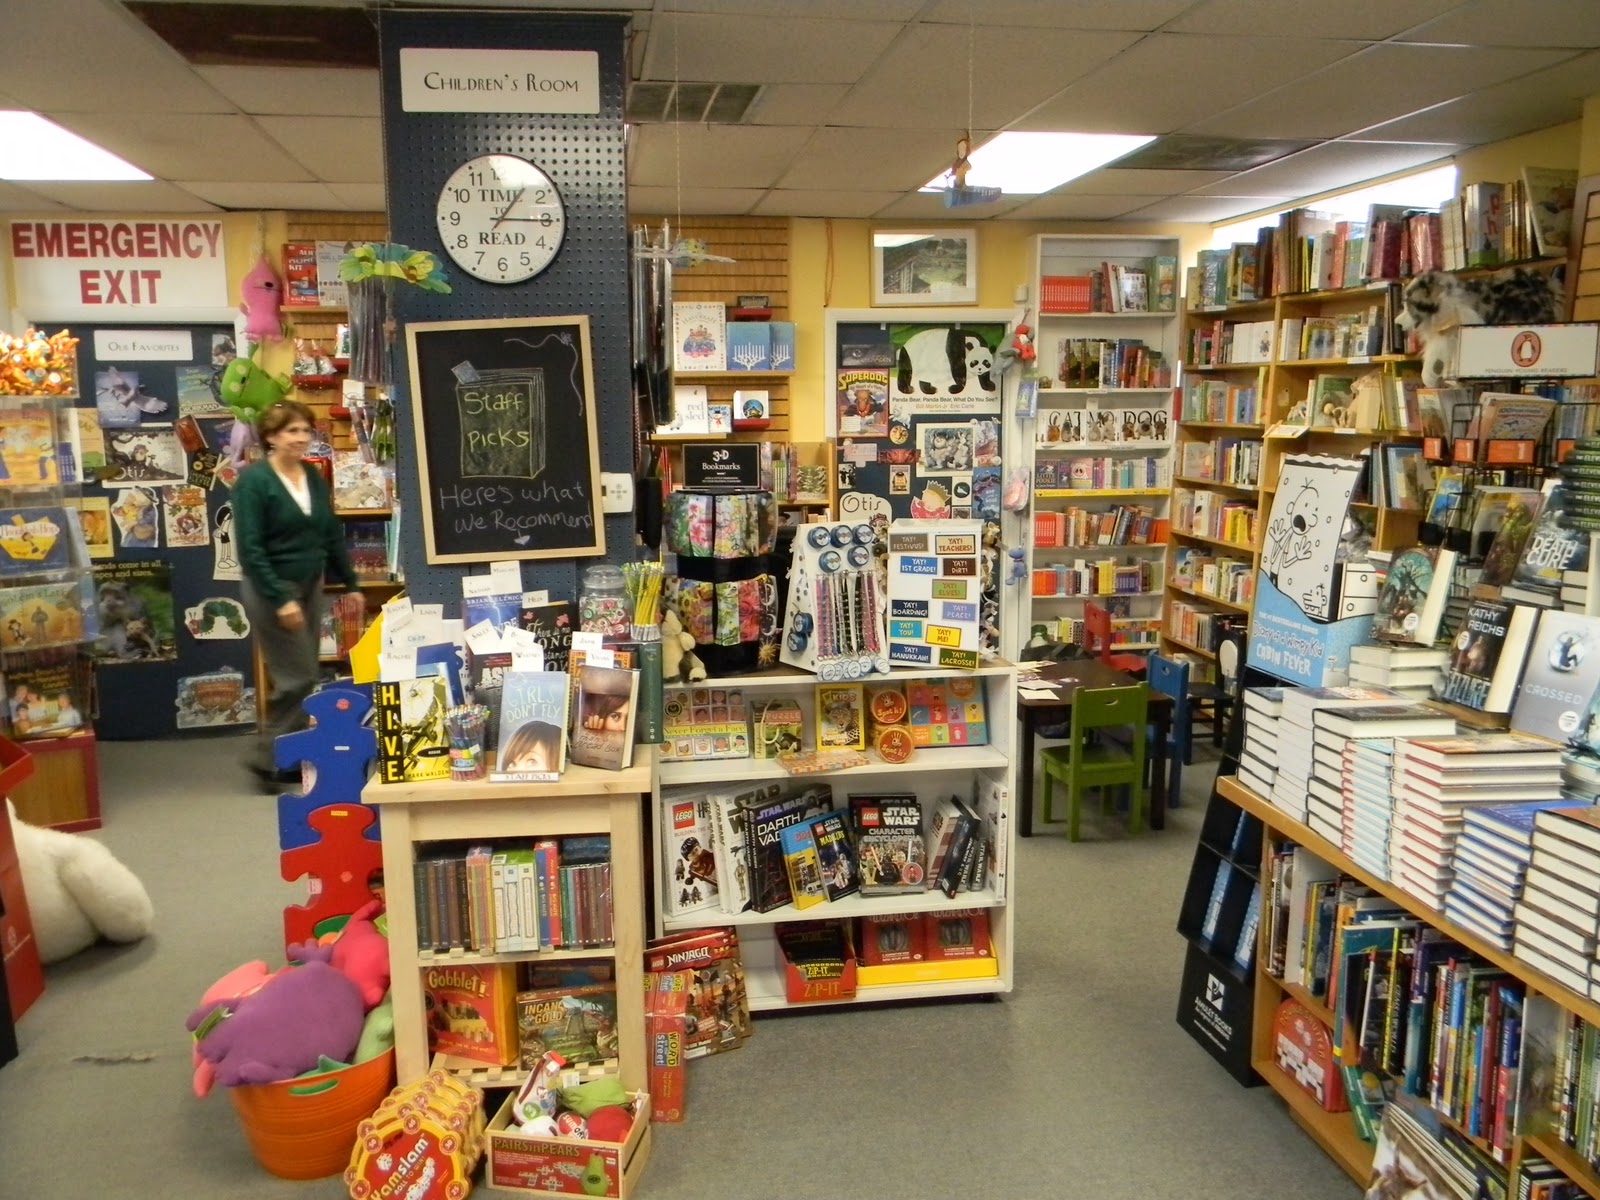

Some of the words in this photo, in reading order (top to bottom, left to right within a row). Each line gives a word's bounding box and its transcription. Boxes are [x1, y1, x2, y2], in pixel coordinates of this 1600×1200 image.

[526, 73, 579, 93] ROOM
[469, 172, 483, 186] 11
[454, 189, 470, 203] 10
[478, 189, 523, 202] TIME
[535, 190, 546, 204] 2
[494, 206, 507, 214] TO
[450, 212, 460, 226] 9
[541, 213, 552, 226] 3
[11, 222, 221, 258] EMERGENCY
[457, 235, 468, 249] 8
[478, 232, 526, 246] READ
[536, 236, 546, 250] 4
[475, 252, 486, 265] 7
[498, 258, 508, 272] 6
[520, 252, 530, 266] 5
[80, 270, 162, 304] EXIT
[464, 392, 524, 415] Staff
[712, 449, 730, 462] 3-D
[702, 462, 741, 470] Bookmarks
[522, 480, 585, 503] what
[842, 494, 882, 513] Otis
[948, 538, 964, 546] YAY!
[912, 558, 926, 566] YAY!
[1526, 550, 1570, 570] CURE
[1468, 607, 1500, 621] KATHY
[1468, 620, 1506, 637] REICHS
[537, 635, 572, 650] ONG
[904, 646, 918, 654] YAY!
[952, 650, 966, 658] YAY!
[1256, 643, 1281, 666] CABIN
[1284, 651, 1311, 676] FEVER
[1525, 683, 1584, 705] CROSSED
[542, 704, 561, 719] FLY
[766, 712, 800, 720] PUZZLE
[426, 770, 449, 778] WALDEN
[675, 810, 694, 821] LEGO
[862, 812, 879, 821] LEGO
[882, 806, 920, 816] STAR
[757, 814, 800, 836] DARTH
[884, 816, 921, 826] WARS
[758, 831, 780, 846] VAD
[666, 946, 712, 968] NINJAGO
[656, 1034, 666, 1065] Street
[668, 1032, 678, 1066] WORD
